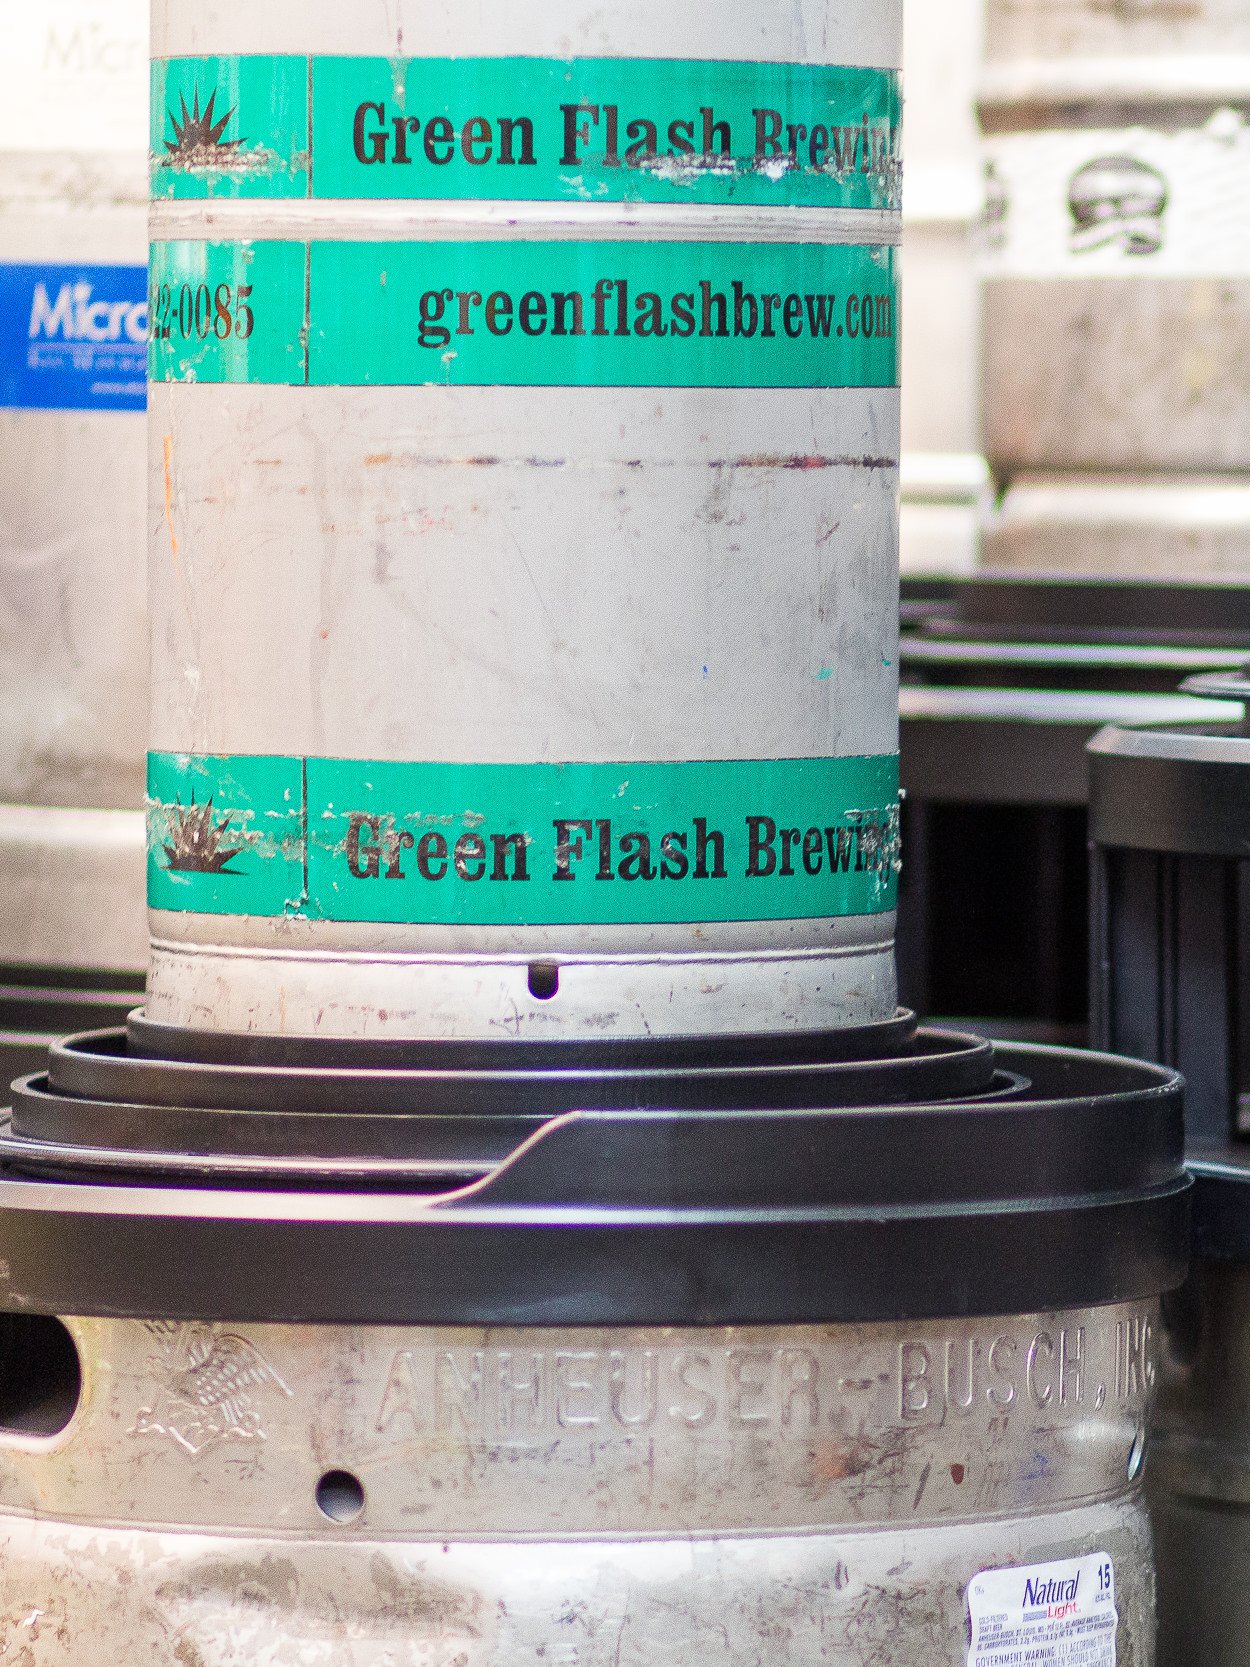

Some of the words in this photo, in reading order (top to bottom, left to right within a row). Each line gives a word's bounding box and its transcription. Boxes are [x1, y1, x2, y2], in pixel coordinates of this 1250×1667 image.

[353, 102, 537, 165] Green
[559, 103, 738, 172] Flash
[417, 278, 892, 348] greenflashbrew.com
[346, 810, 530, 881] Green
[552, 808, 728, 881] Flash
[1022, 1569, 1080, 1608] Natural
[1098, 1563, 1111, 1590] 15
[1047, 1601, 1079, 1619] Light
[975, 1650, 1022, 1667] GOVERNMENT
